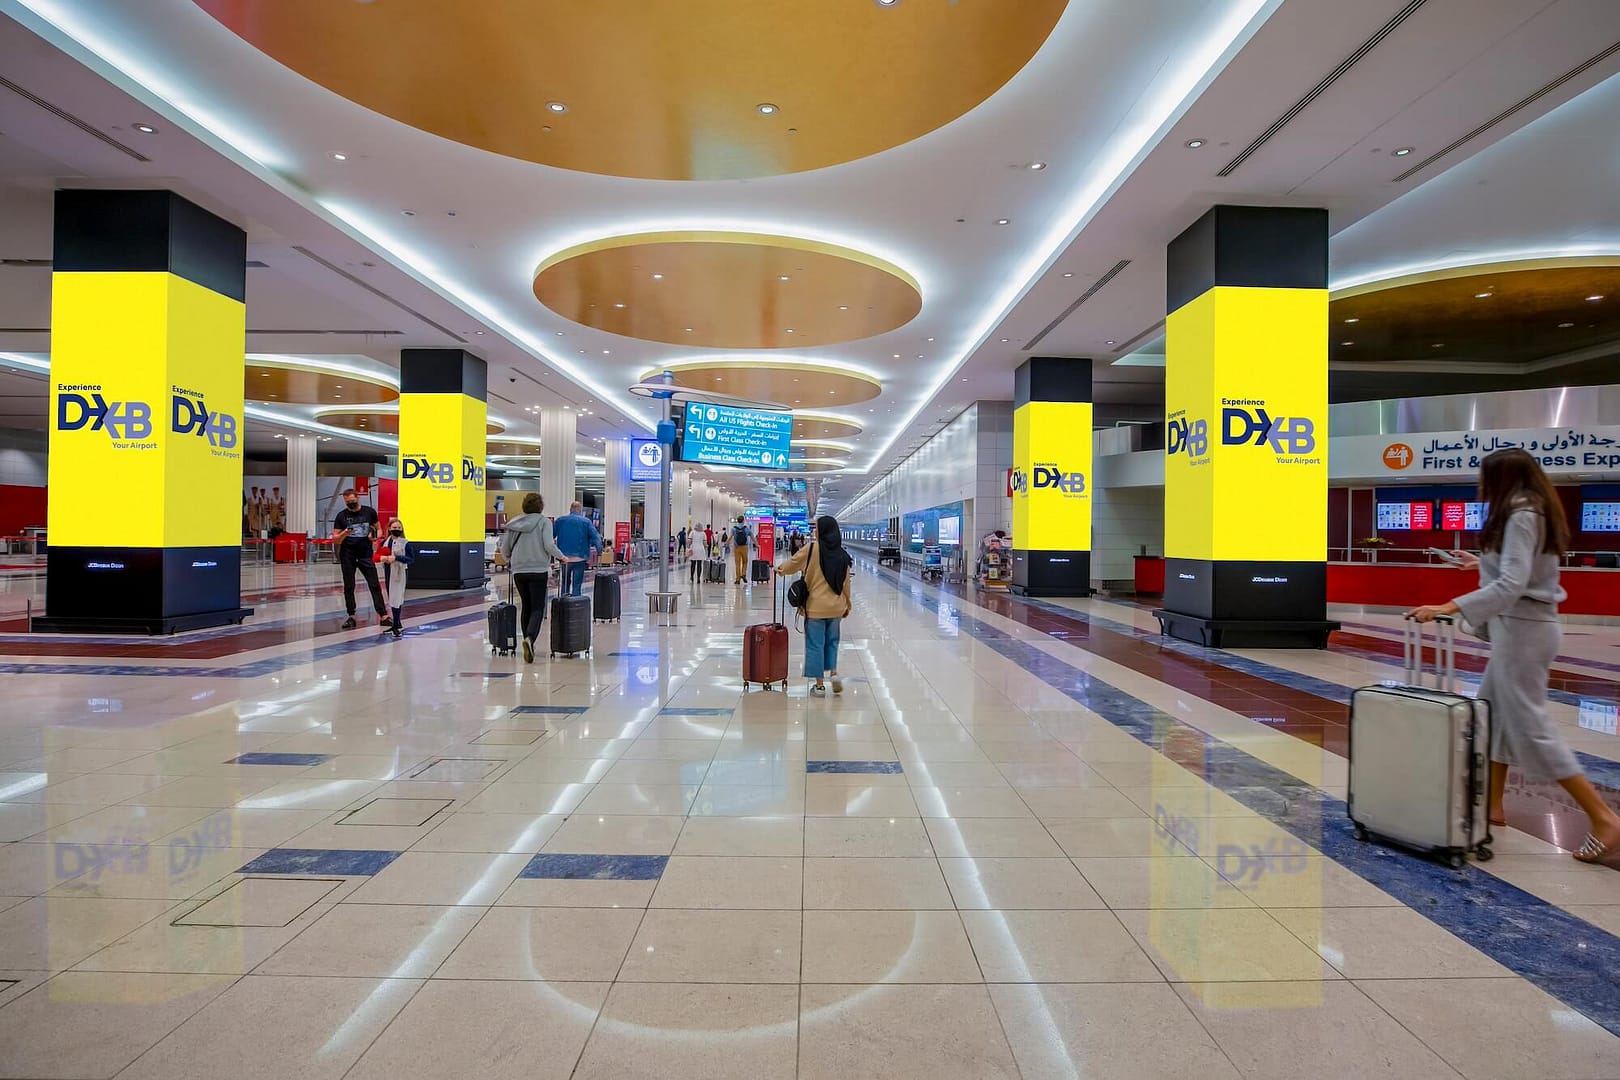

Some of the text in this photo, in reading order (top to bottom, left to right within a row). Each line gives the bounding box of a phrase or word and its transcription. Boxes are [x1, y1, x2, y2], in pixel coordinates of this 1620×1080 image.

[58, 383, 102, 392] Experience
[172, 385, 204, 399] Experience
[1221, 398, 1265, 406] Experience
[58, 393, 153, 439] DXB
[1168, 409, 1186, 420] Experience
[171, 395, 237, 449] DXB
[737, 418, 755, 427] Flights
[1168, 418, 1208, 457] DXB
[1222, 408, 1316, 454] DXB
[130, 441, 158, 450] Airport
[718, 435, 730, 443] First
[730, 436, 744, 444] Class
[1423, 433, 1479, 454] الأعمال
[1541, 430, 1585, 451] الأولى
[210, 449, 240, 459] Your Airport
[698, 452, 721, 461] Business
[722, 454, 736, 462] Class
[1293, 457, 1320, 465] Airport
[1423, 455, 1463, 469] First
[1468, 455, 1481, 468] &
[402, 458, 455, 484] DXB
[1033, 467, 1086, 493] DXB
